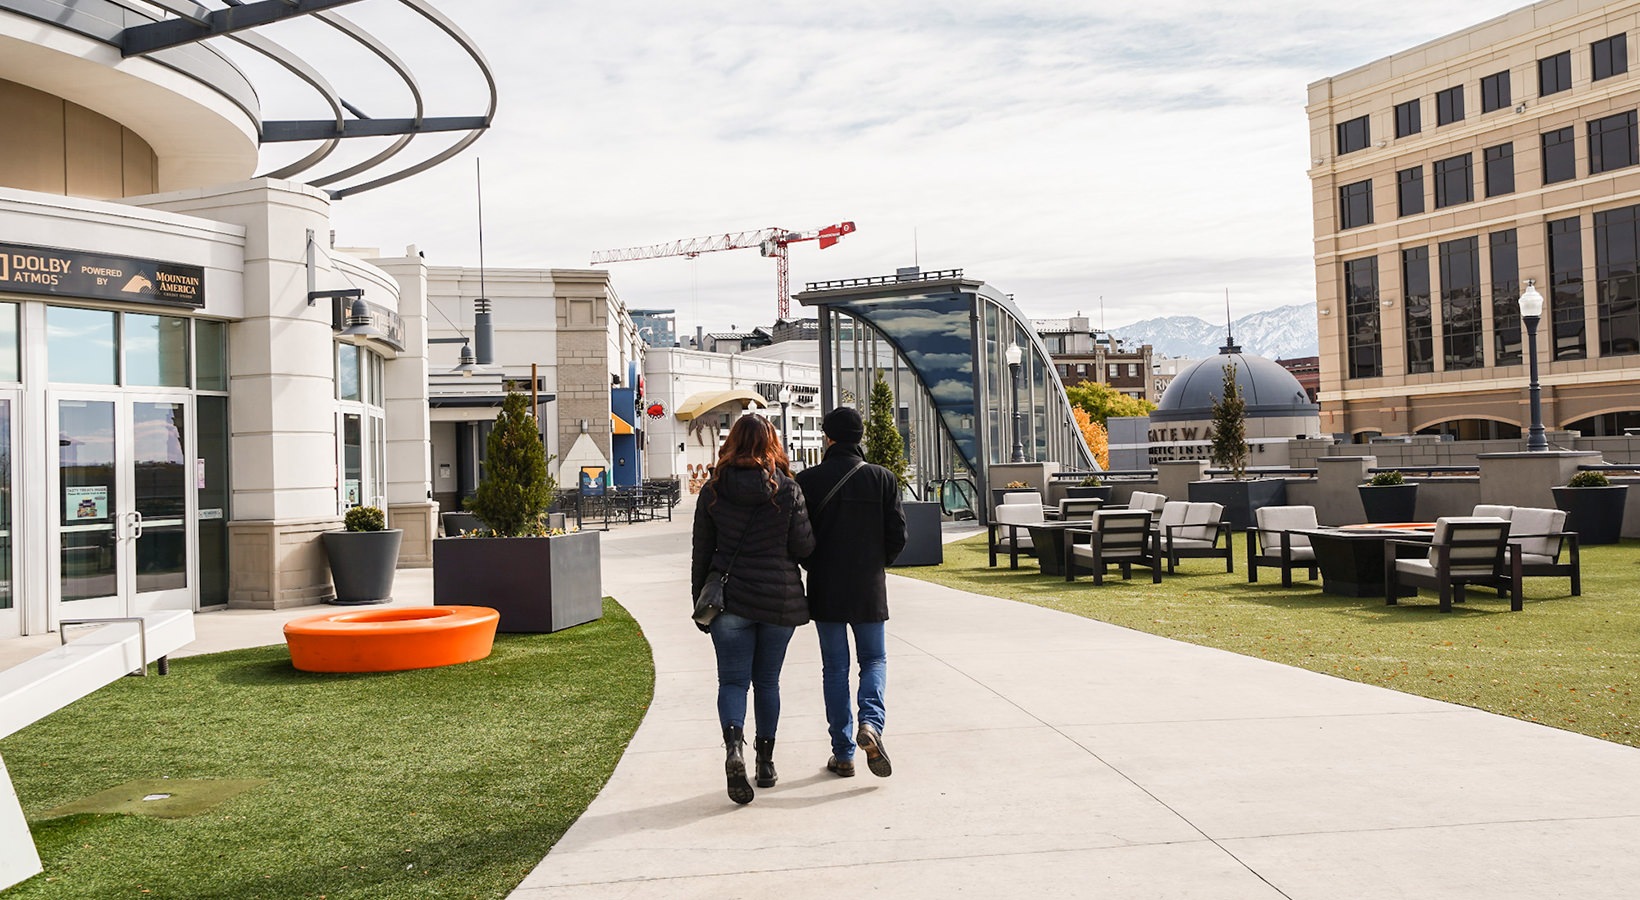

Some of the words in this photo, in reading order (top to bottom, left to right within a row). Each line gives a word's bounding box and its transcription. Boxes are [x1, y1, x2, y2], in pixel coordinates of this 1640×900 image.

[13, 254, 71, 274] DOLBY
[14, 271, 59, 285] ATMOS
[81, 266, 122, 277] POWERED
[96, 277, 108, 286] BY
[156, 271, 199, 286] MOUNTAIN
[160, 282, 196, 295] AMERICA
